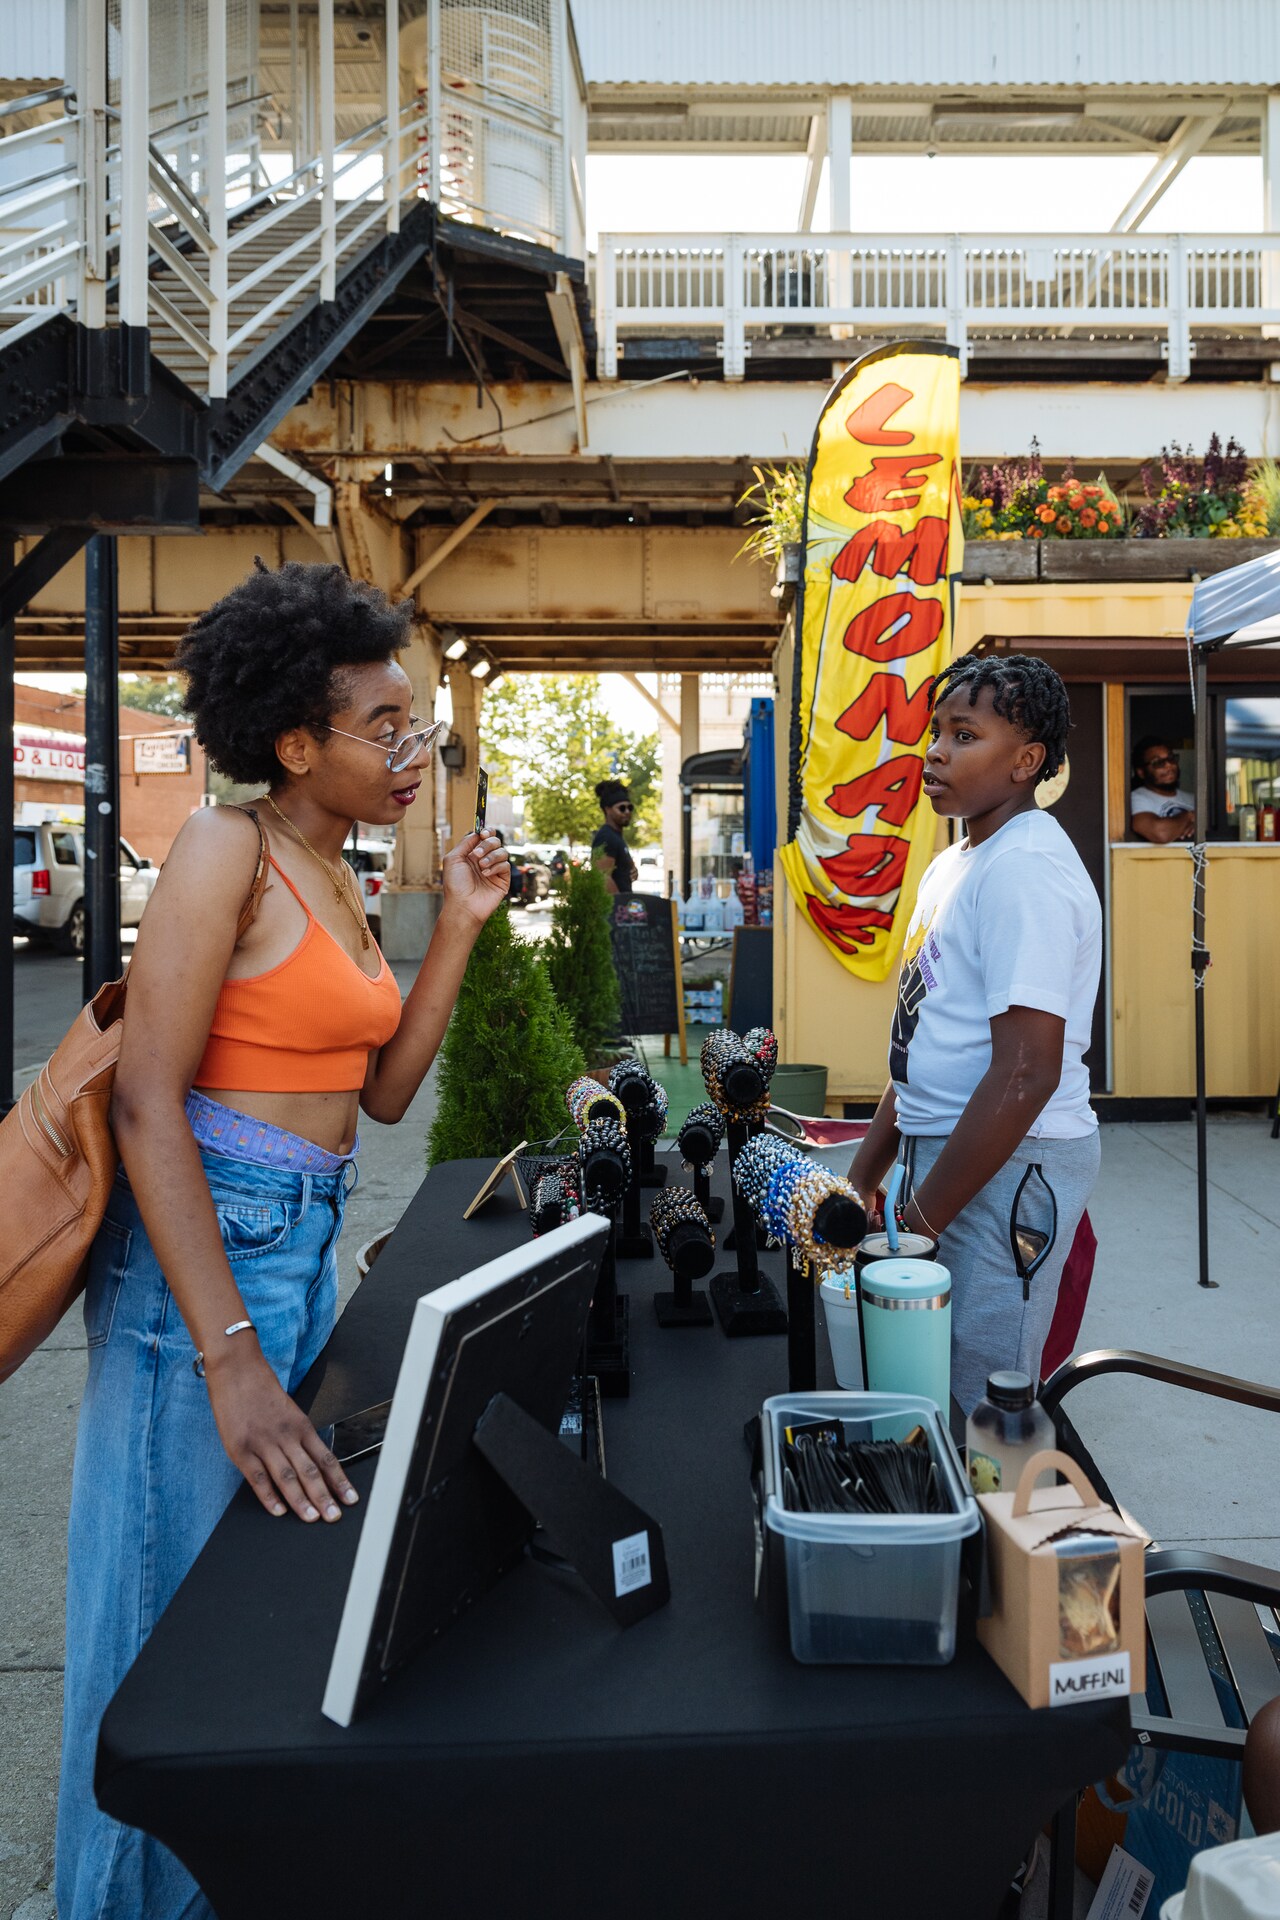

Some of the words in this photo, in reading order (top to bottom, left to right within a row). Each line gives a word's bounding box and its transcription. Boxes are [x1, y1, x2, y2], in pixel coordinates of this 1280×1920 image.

[803, 382, 951, 955] LEMONADE
[32, 750, 41, 765] &
[1055, 1667, 1125, 1696] MUFFINI
[1162, 1766, 1201, 1808] STAYS
[1154, 1780, 1202, 1847] COLD
